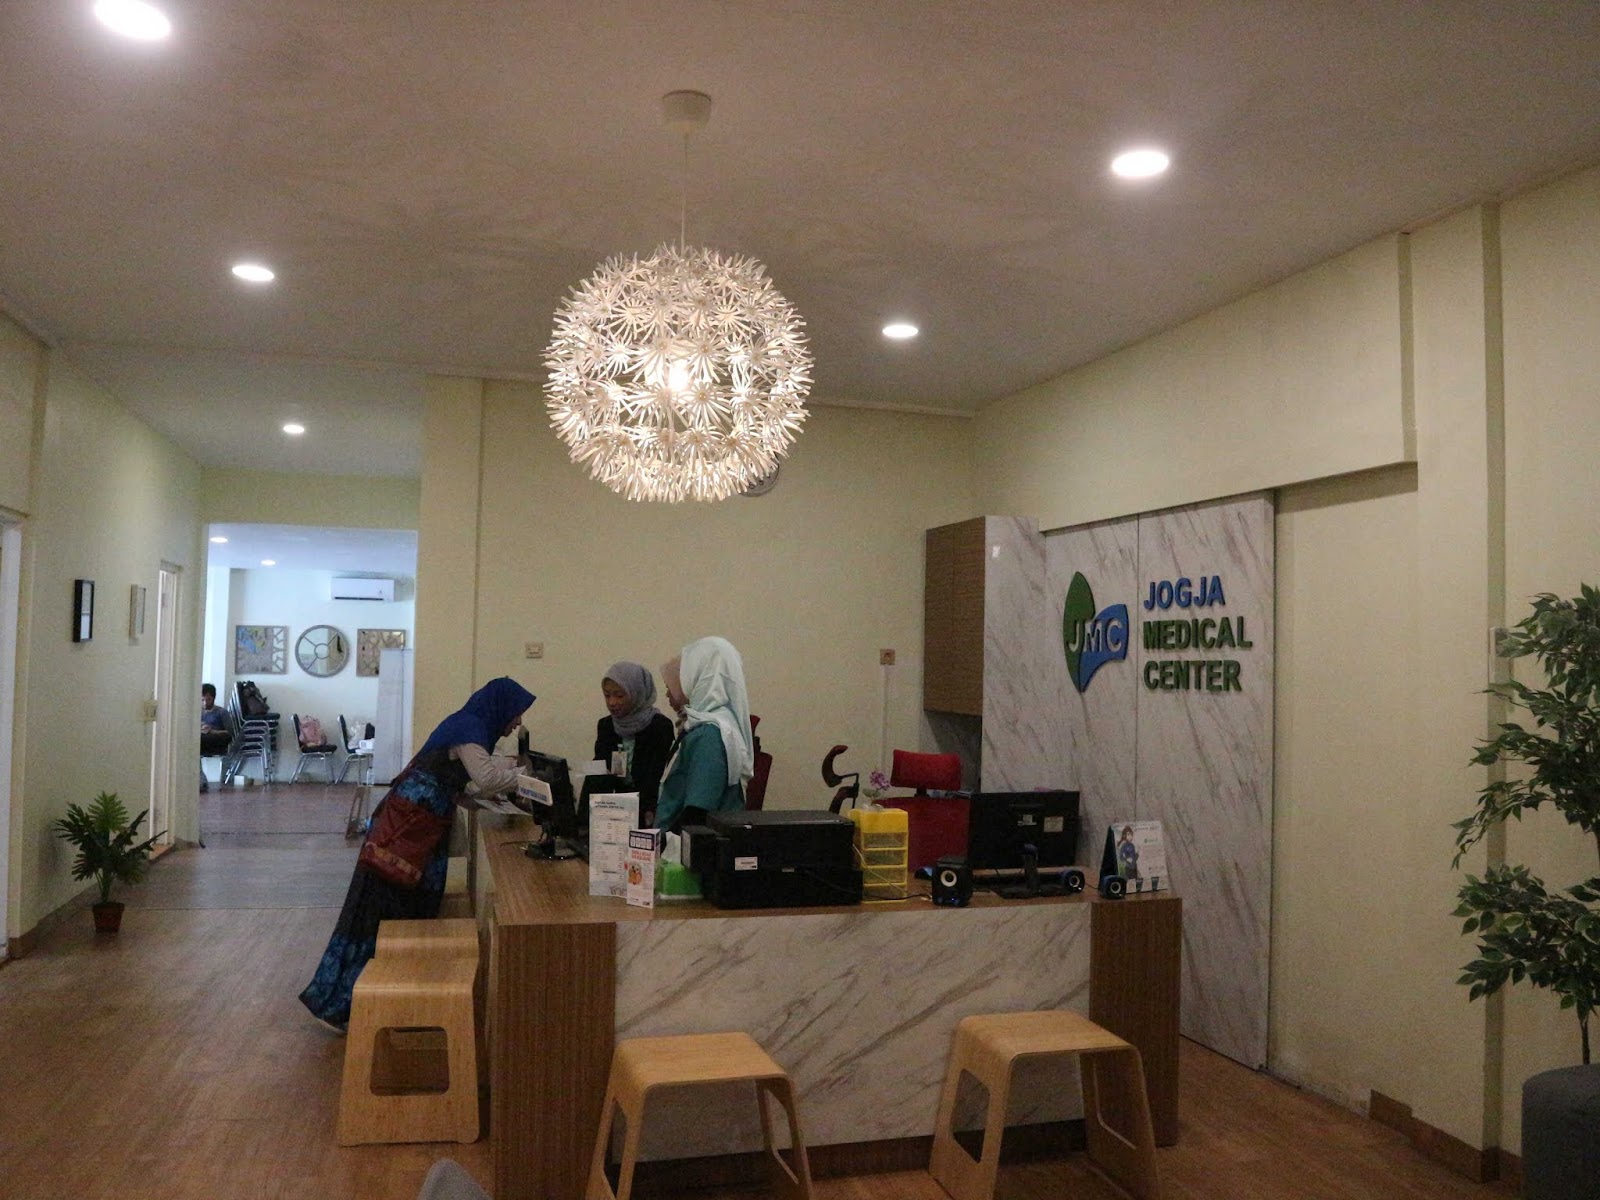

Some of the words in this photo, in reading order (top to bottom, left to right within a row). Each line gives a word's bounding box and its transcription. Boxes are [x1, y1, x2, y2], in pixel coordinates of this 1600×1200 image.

[1143, 575, 1226, 610] JOGJA
[1067, 618, 1123, 652] JMC
[1142, 616, 1253, 650] MEDICAL
[1143, 659, 1243, 692] CENTER
